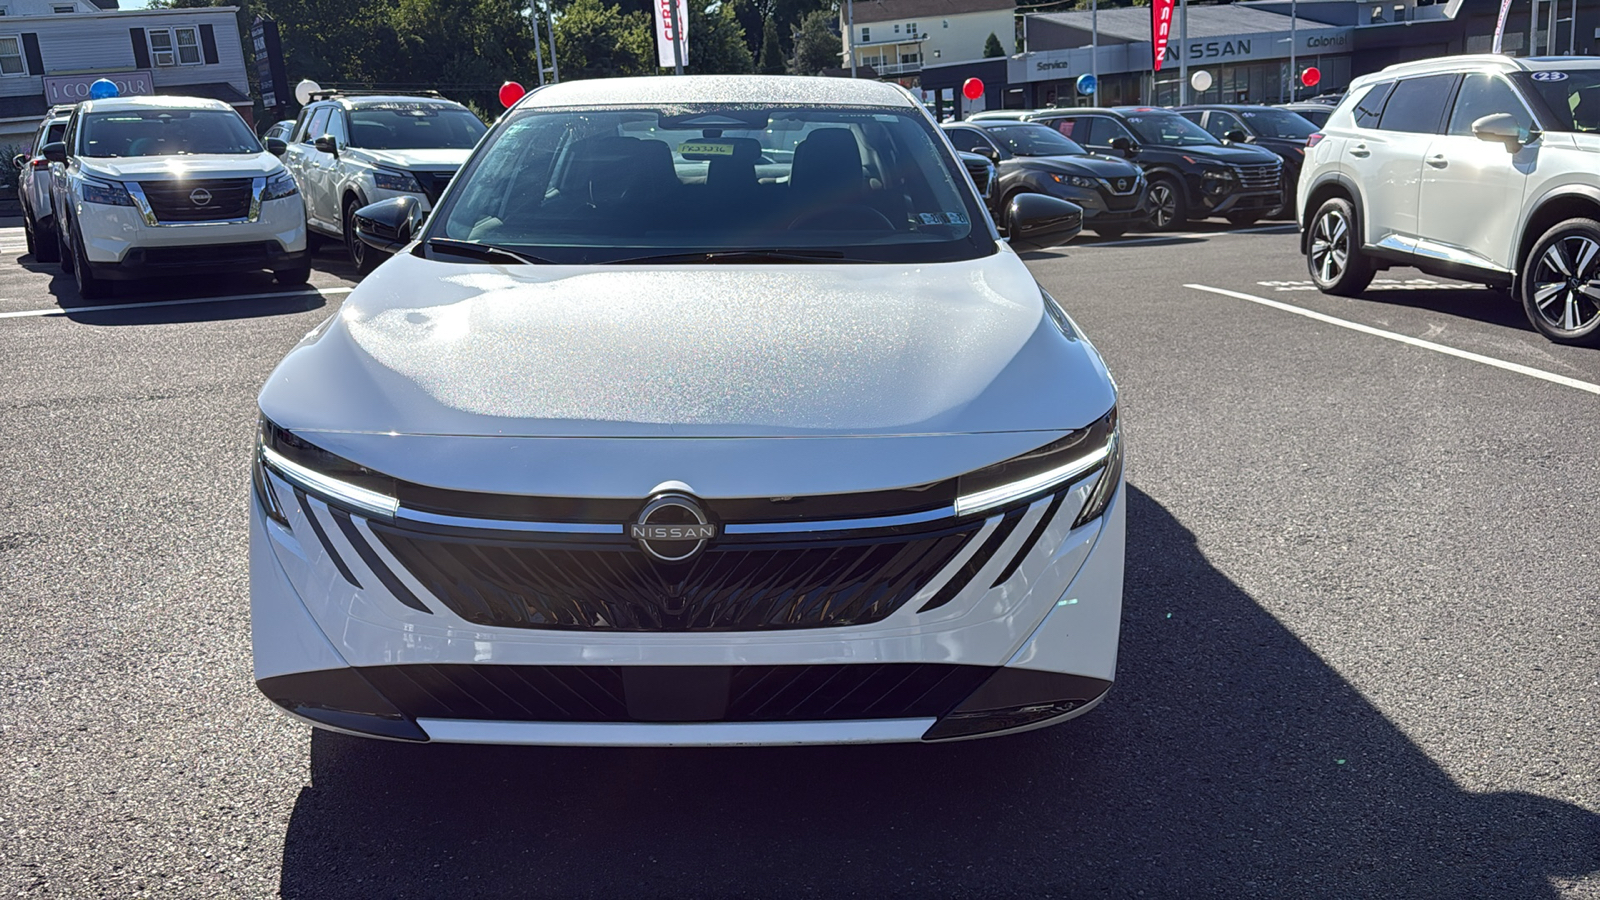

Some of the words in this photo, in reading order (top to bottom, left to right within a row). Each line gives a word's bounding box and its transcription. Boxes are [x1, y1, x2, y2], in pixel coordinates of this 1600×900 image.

[1307, 34, 1347, 48] Colonial
[1166, 40, 1251, 61] NSSAN
[1037, 60, 1068, 71] Service
[633, 527, 712, 537] NISSAN
